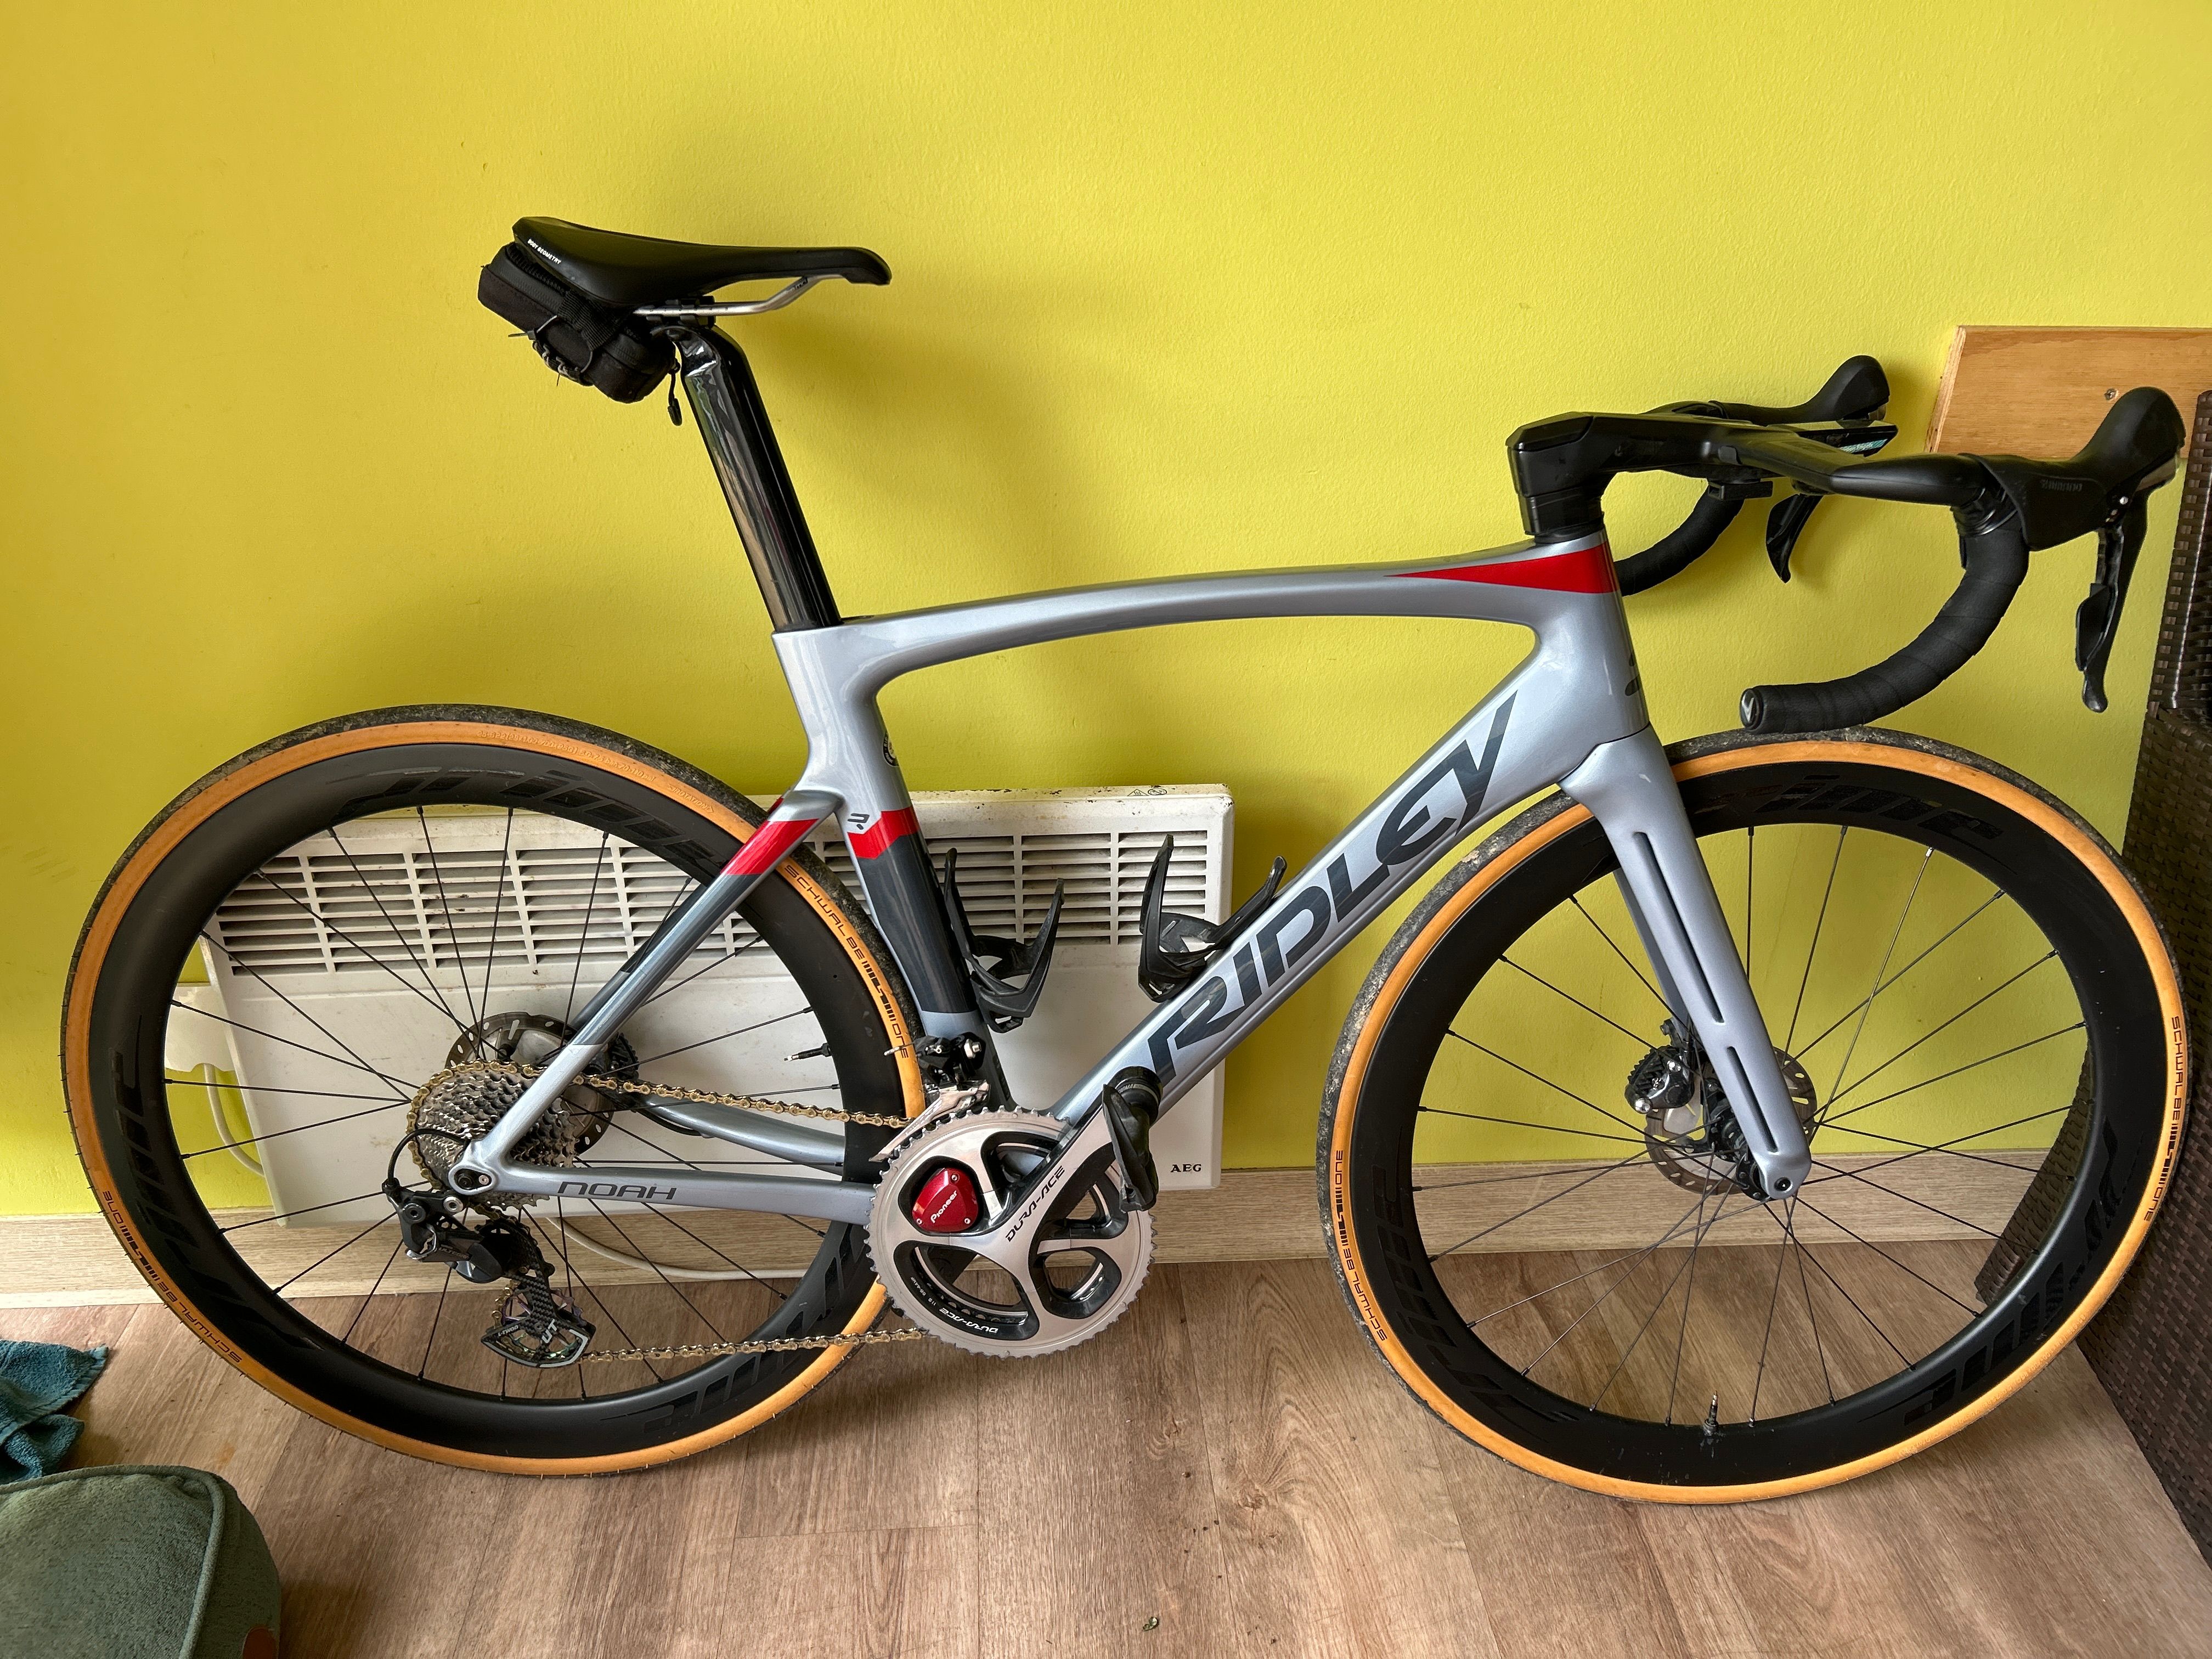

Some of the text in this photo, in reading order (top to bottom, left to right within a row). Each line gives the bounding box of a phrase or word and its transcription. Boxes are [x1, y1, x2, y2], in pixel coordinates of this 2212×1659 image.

[537, 246, 562, 265] GEOMETRY
[1147, 689, 1519, 1081] RIDLEY
[784, 864, 909, 1059] SCHWALBE ONE
[2143, 1015, 2183, 1222] SCHWALBE ONE
[557, 1181, 678, 1200] NOAH
[1170, 1164, 1202, 1173] AEG
[930, 1189, 958, 1224] Pioneer
[1005, 1165, 1065, 1243] DURA-ACE
[1334, 1149, 1388, 1341] SCHWALBE ONE
[103, 1189, 243, 1363] SCHWALBE ONE
[541, 1318, 558, 1344] UT
[939, 1307, 1000, 1334] DURA-ACE
